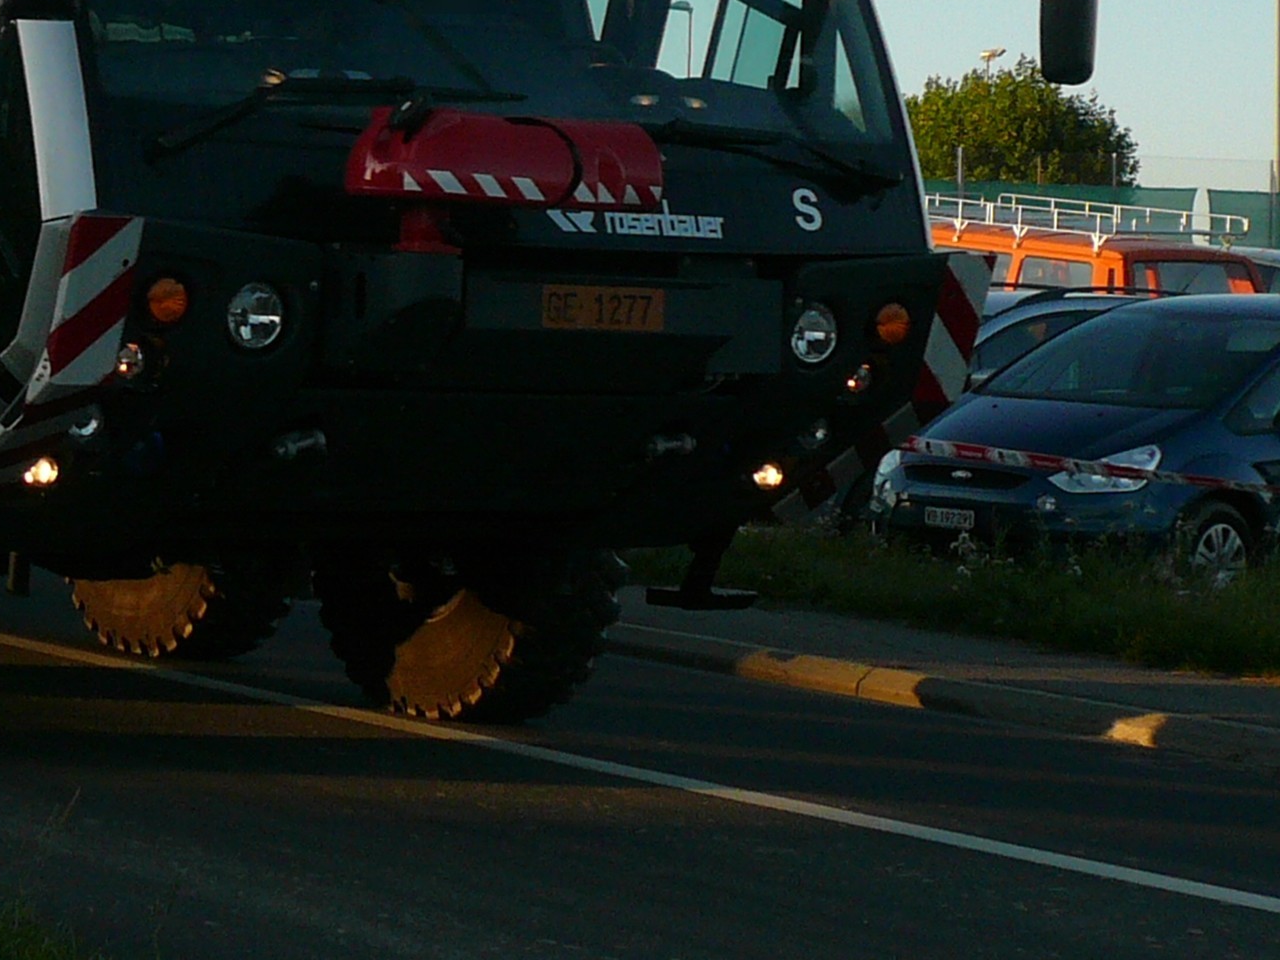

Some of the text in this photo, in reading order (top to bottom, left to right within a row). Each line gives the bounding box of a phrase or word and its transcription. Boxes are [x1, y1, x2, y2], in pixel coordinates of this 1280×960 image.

[605, 199, 724, 239] rosenbauer
[791, 187, 823, 232] S
[594, 292, 653, 326] 1277
